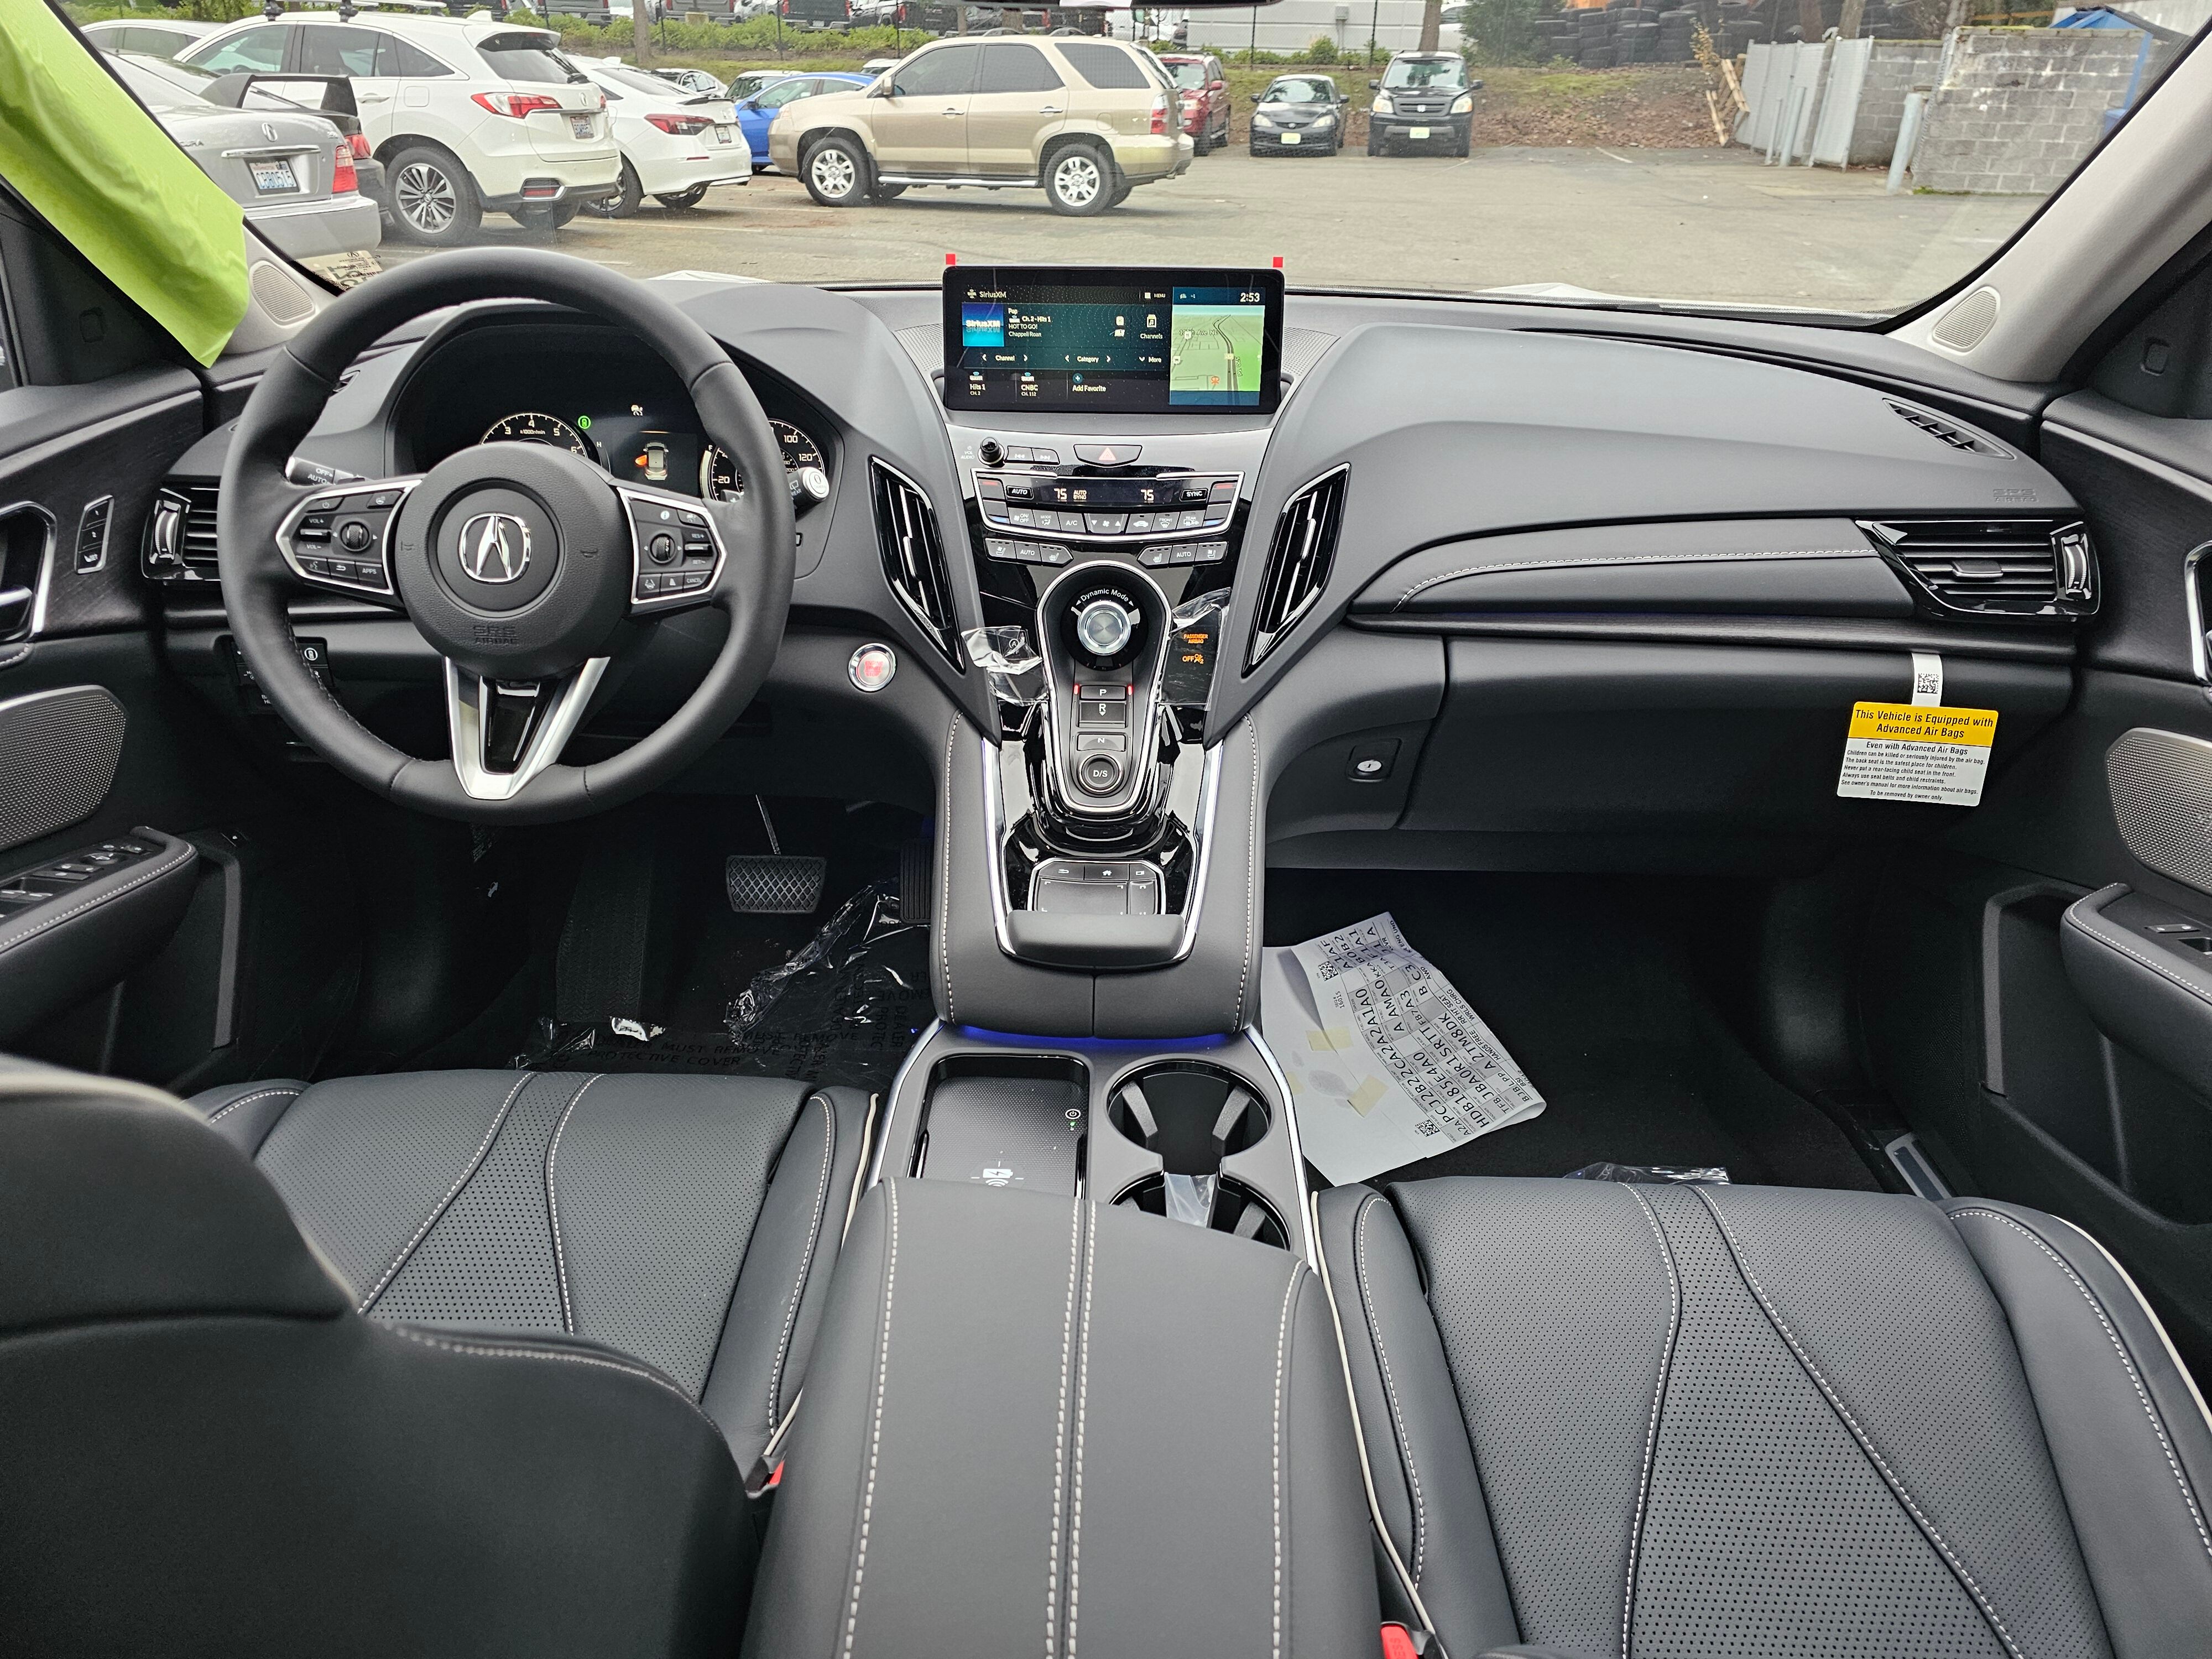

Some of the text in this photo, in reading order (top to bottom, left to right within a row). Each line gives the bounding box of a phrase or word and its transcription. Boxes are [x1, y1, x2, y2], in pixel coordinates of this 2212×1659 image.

[1240, 293, 1260, 302] 2:53
[504, 426, 512, 435] 3
[554, 428, 560, 436] 5
[784, 435, 798, 443] 100
[307, 473, 328, 484] AUTO
[316, 468, 329, 477] OFF
[1054, 488, 1067, 500] 75
[1140, 489, 1154, 501] 75
[1080, 588, 1129, 603] Dynamic Mode
[1099, 703, 1107, 712] R
[1855, 709, 1993, 727] This Vehicle is Equipped with
[1876, 723, 1964, 739] Advanced Air Bags
[1901, 744, 1936, 753] Advanced
[1950, 747, 1968, 756] Bags
[1093, 769, 1108, 778] D/S
[1365, 926, 1376, 938] A
[1366, 962, 1381, 978] KKA
[1389, 919, 1475, 1021] WRLS CHRG ENG UND
[1417, 985, 1428, 995] B
[1334, 990, 1345, 1009] 16015
[1410, 1008, 1426, 1026] FB7
[1392, 1021, 1405, 1035] A
[1419, 965, 1526, 1087] BSI HANDS FREE RR HT SEAT AWD
[1482, 1060, 1496, 1072] A
[1497, 1070, 1514, 1087] LPP
[1512, 1086, 1530, 1102] BJB
[1493, 1097, 1510, 1114] TFB
[1453, 1120, 1471, 1136] A2A
